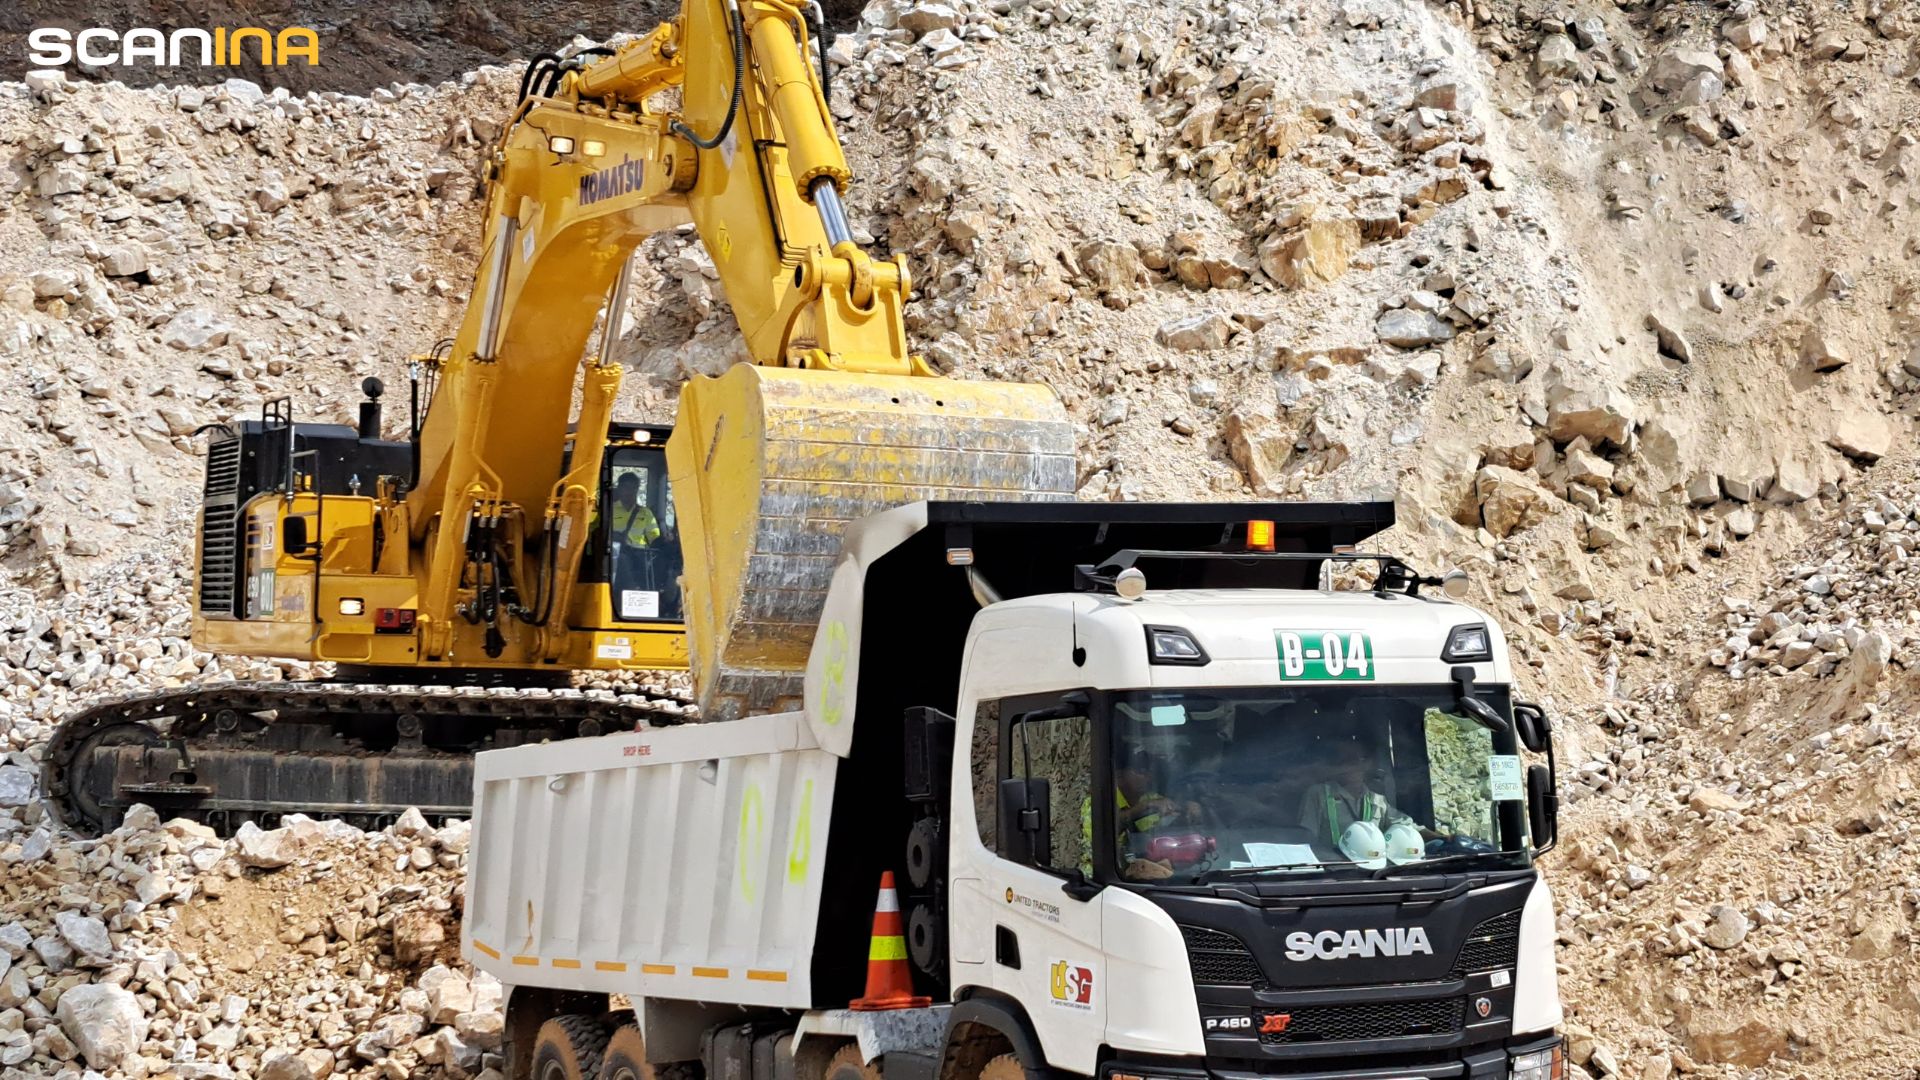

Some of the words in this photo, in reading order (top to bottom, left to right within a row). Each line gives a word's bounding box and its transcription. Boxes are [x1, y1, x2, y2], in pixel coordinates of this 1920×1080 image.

[579, 153, 644, 206] KOMATSU
[1280, 631, 1369, 677] B-04
[1013, 893, 1032, 907] UNITED
[1032, 899, 1060, 916] TRACTORS
[1284, 926, 1434, 961] SCANIA
[1206, 1019, 1218, 1030] P
[1219, 1017, 1252, 1029] 460
[1261, 1013, 1292, 1033] XT
